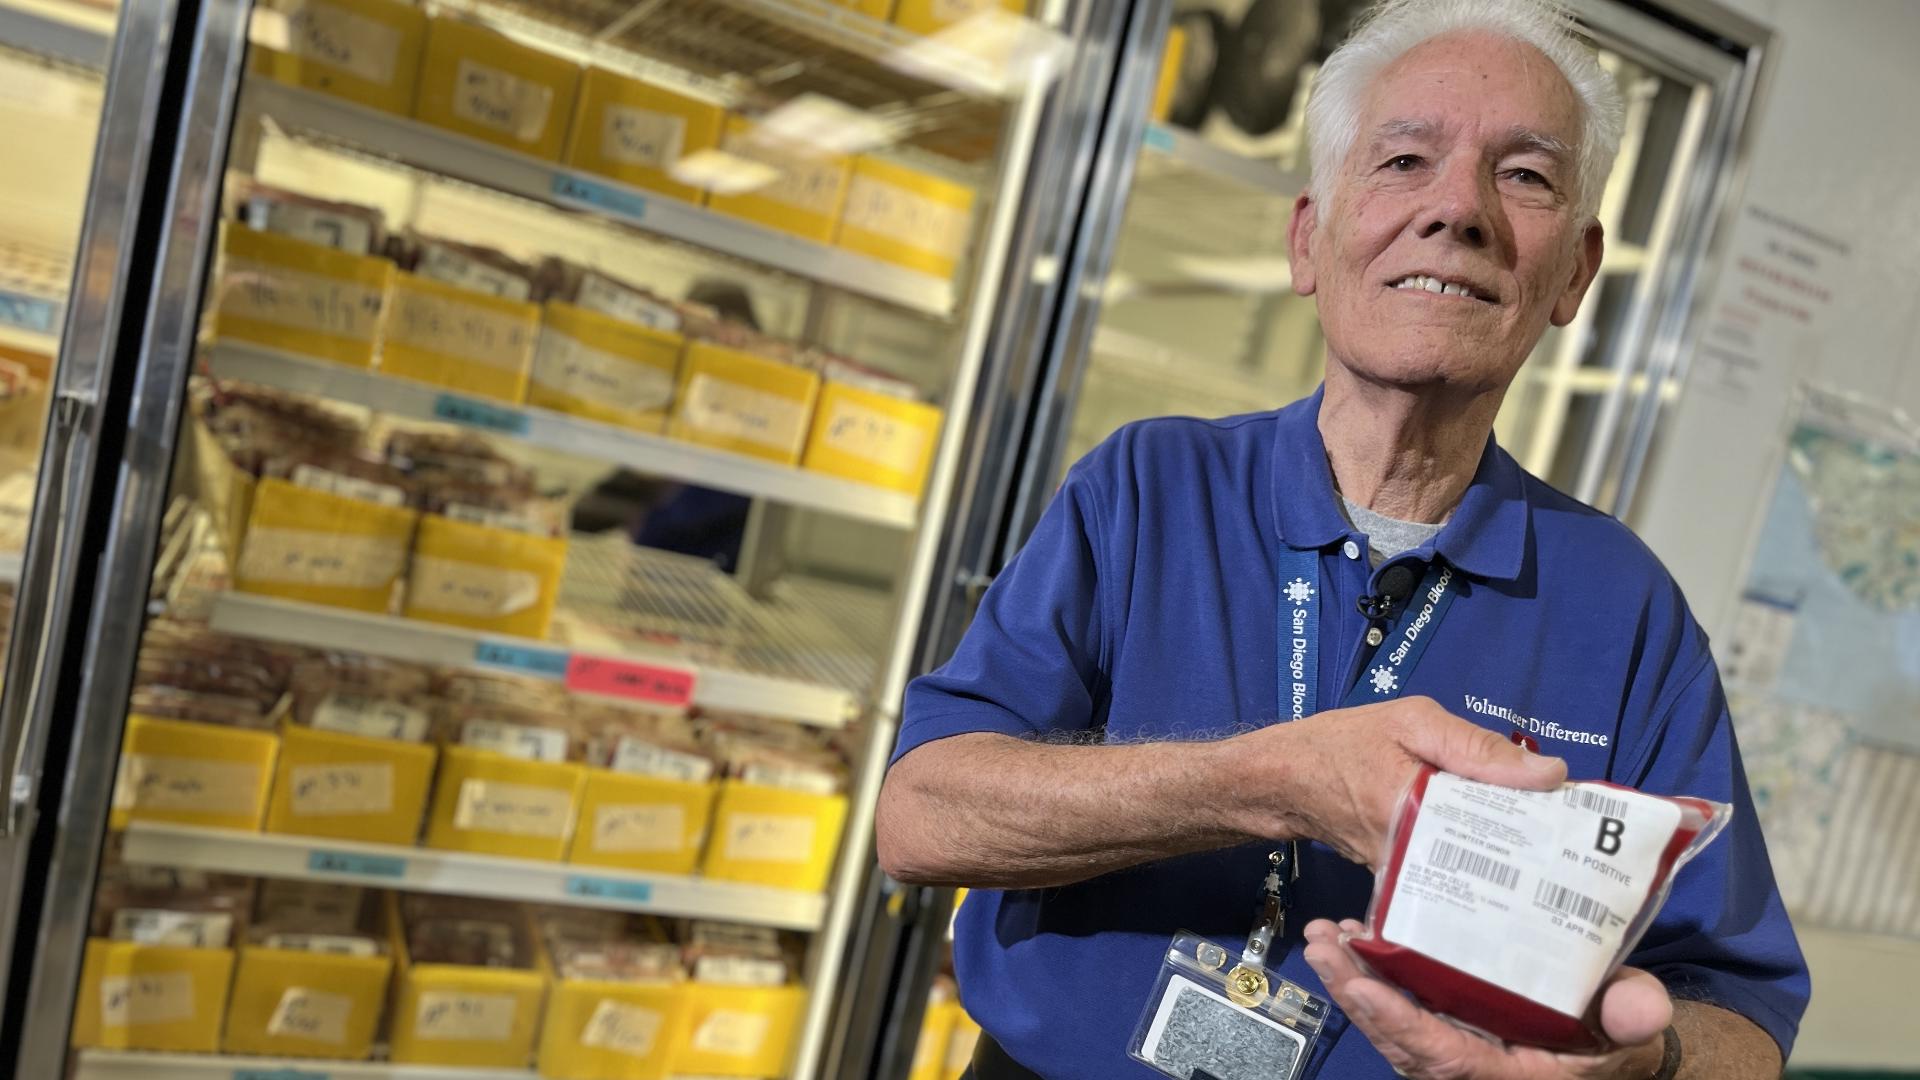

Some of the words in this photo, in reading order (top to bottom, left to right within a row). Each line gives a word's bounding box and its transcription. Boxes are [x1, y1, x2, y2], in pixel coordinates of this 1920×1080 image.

[1292, 608, 1307, 635] San
[1389, 640, 1411, 666] San
[1405, 603, 1433, 641] Diego
[1289, 638, 1307, 680] Diego
[1464, 694, 1528, 729] Volunteer
[1529, 717, 1609, 747] Difference
[1594, 816, 1626, 857] B
[1562, 848, 1580, 862] Rh
[1583, 856, 1633, 887] POSITIVE
[1565, 921, 1585, 936] APR
